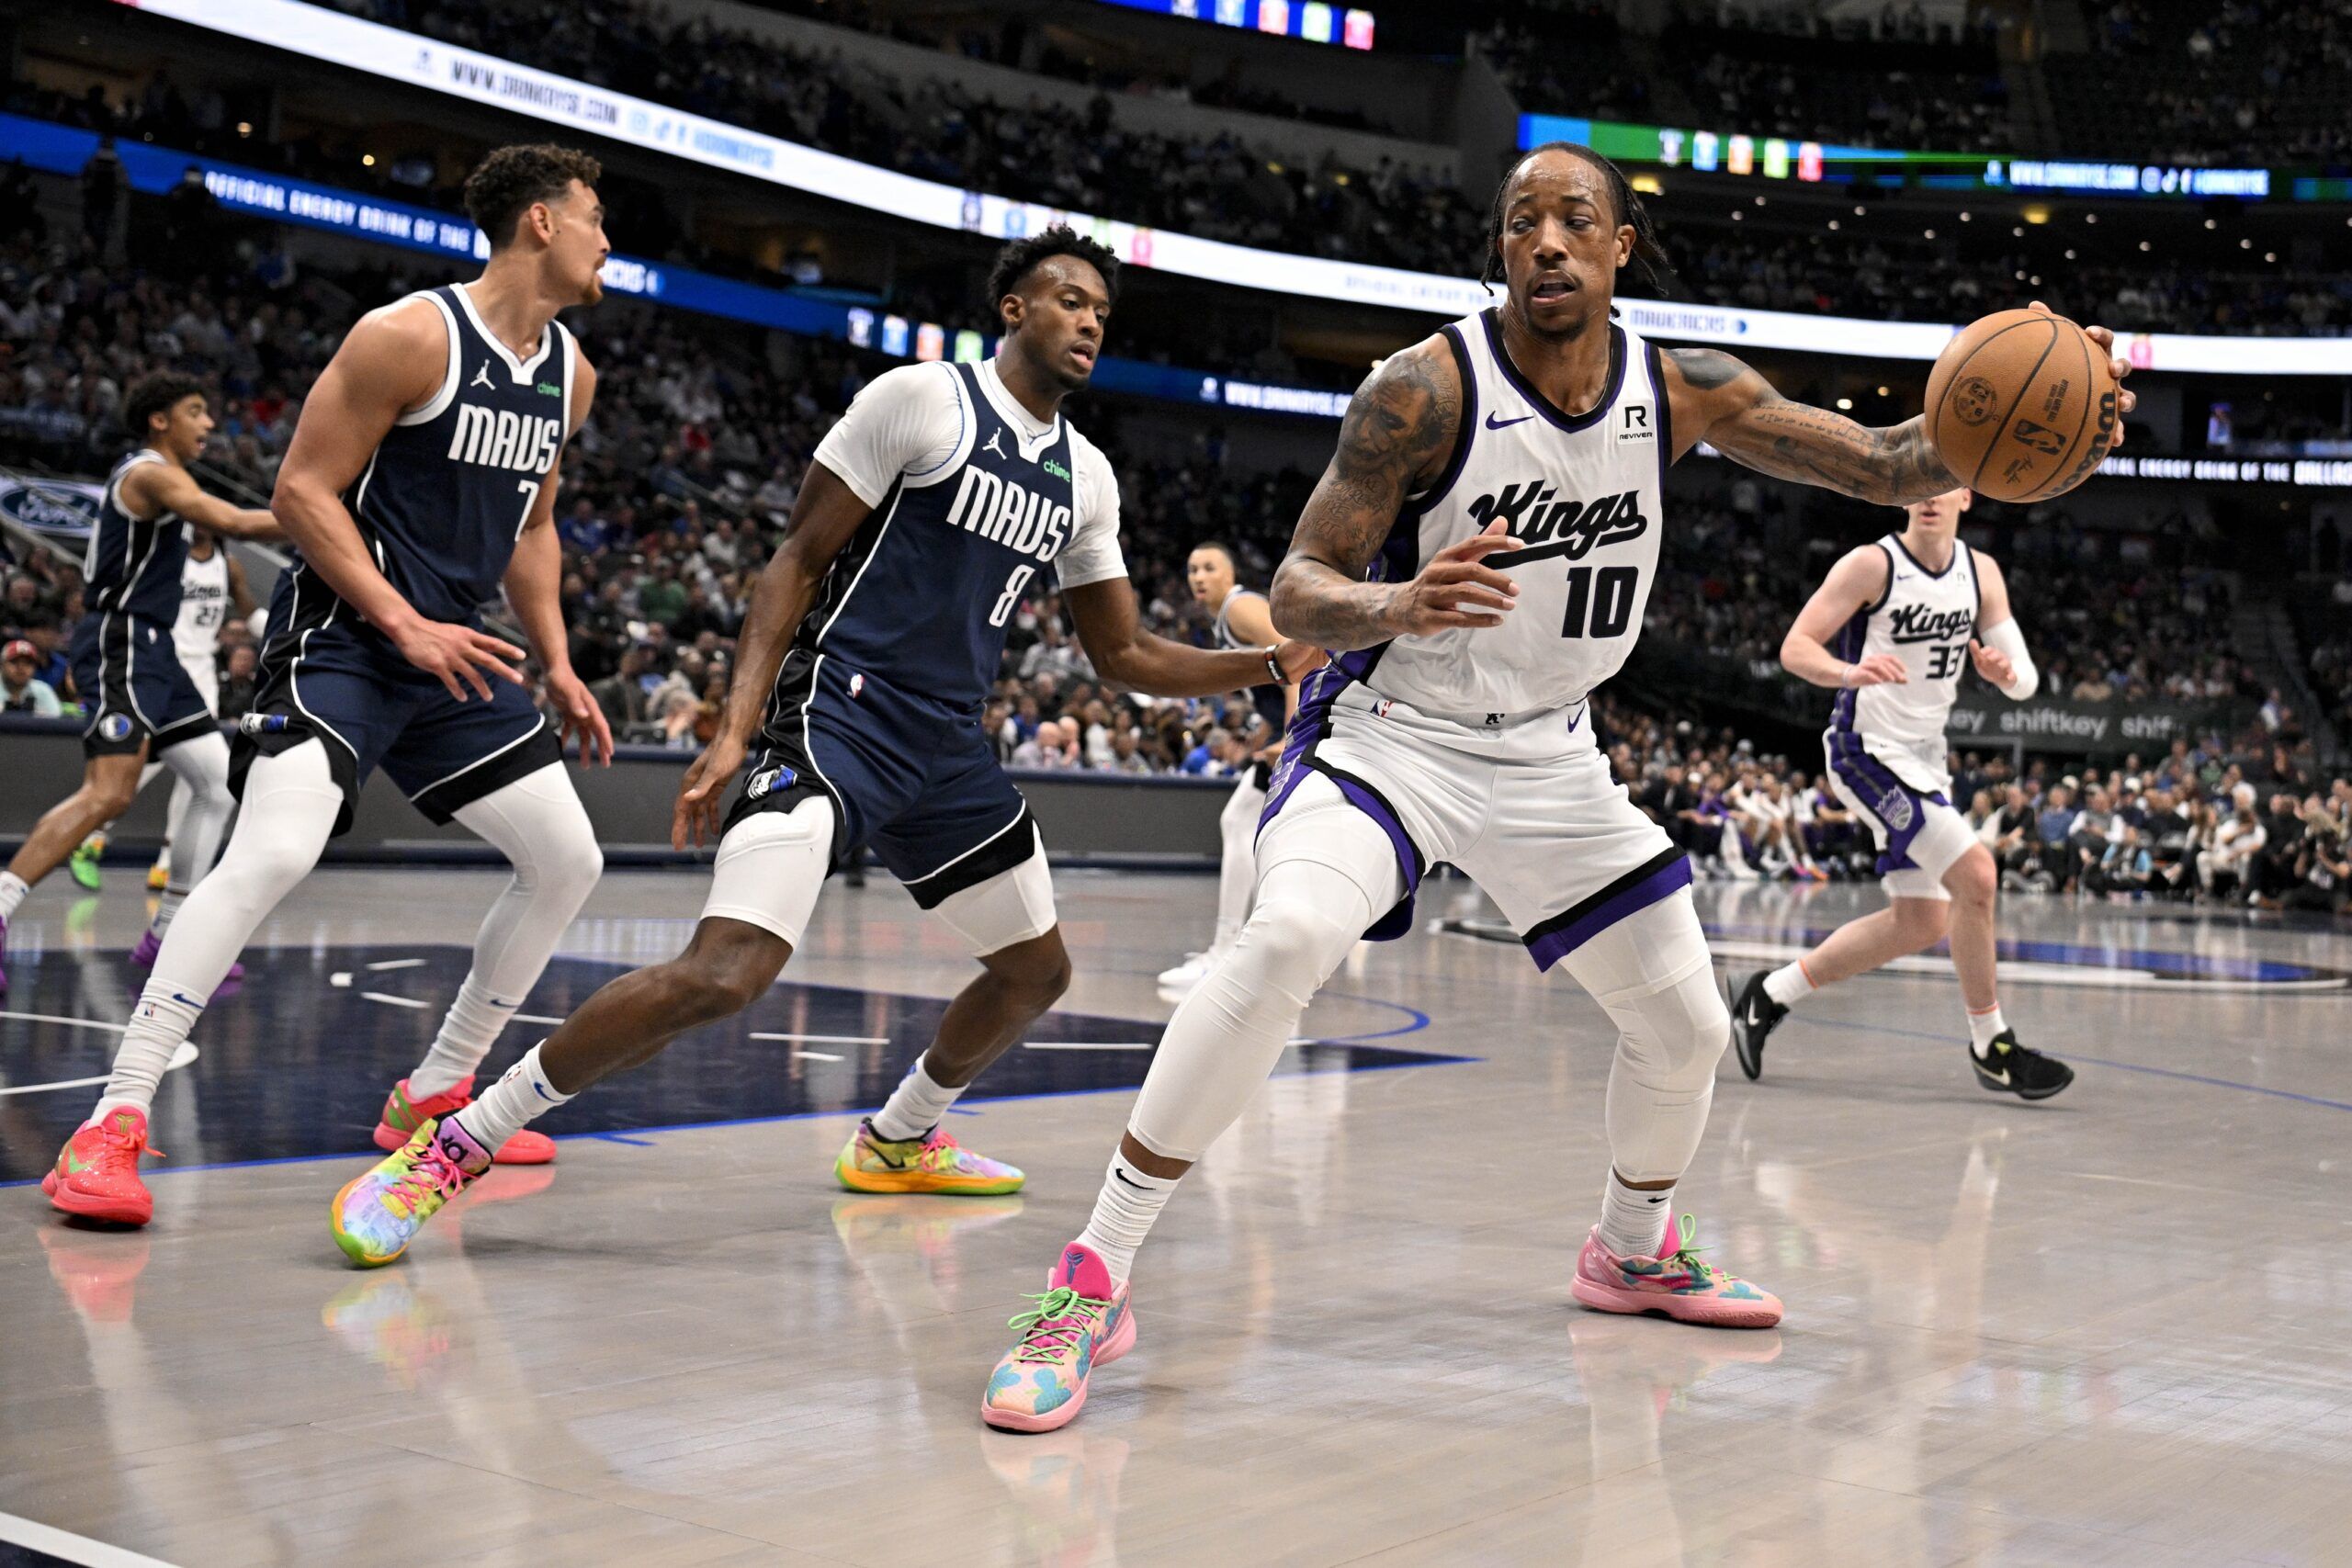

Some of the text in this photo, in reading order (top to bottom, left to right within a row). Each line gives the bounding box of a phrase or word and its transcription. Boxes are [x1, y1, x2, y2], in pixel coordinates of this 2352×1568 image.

[288, 189, 356, 226] ENERGY
[358, 205, 413, 239] DRINK
[447, 402, 560, 475] MAVS
[1619, 432, 1653, 440] REVIVER
[1624, 405, 1647, 428] R
[1043, 458, 1070, 483] chime
[514, 479, 540, 542] 7
[945, 464, 1070, 563] MAVS
[1467, 479, 1647, 570] Kings
[989, 564, 1035, 627] 8
[1561, 566, 1639, 638] 10
[1889, 604, 1972, 644] Kings
[1926, 644, 1966, 679] 33
[1999, 706, 2109, 742] shiftkey
